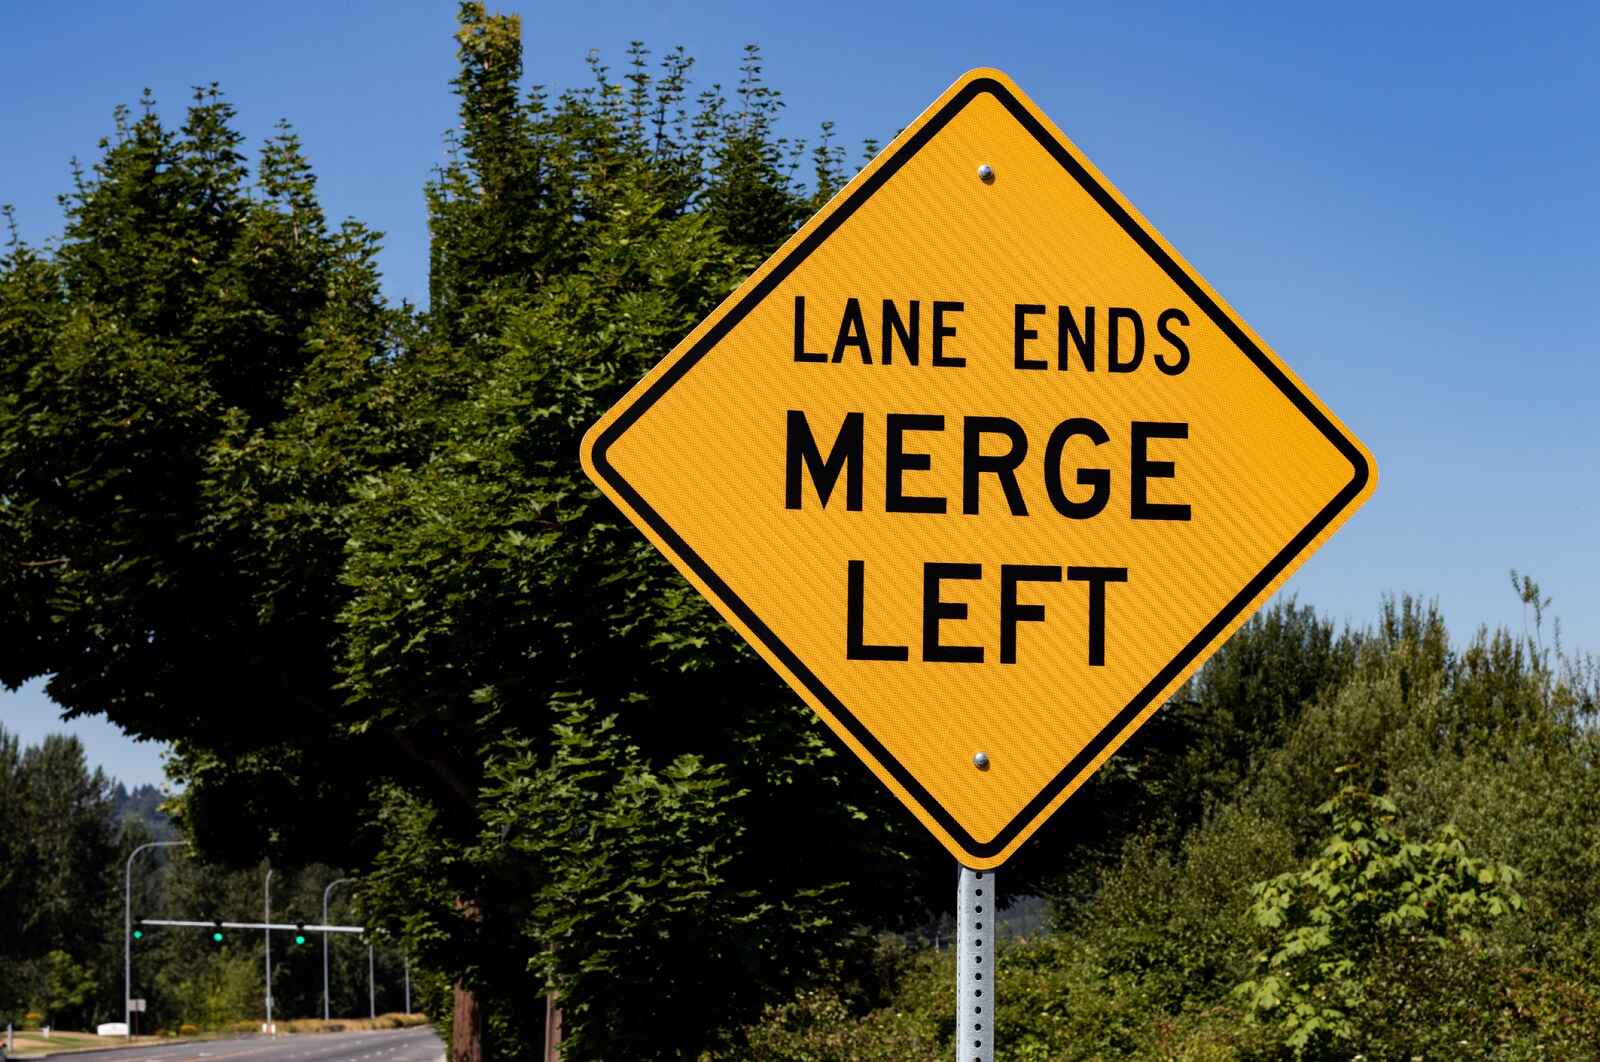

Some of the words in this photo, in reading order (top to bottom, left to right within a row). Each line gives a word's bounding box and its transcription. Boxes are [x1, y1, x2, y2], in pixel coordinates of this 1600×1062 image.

[794, 296, 966, 367] LANE
[1014, 304, 1190, 375] ENDS
[785, 410, 1192, 521] MERGE
[847, 560, 1128, 666] LEFT
